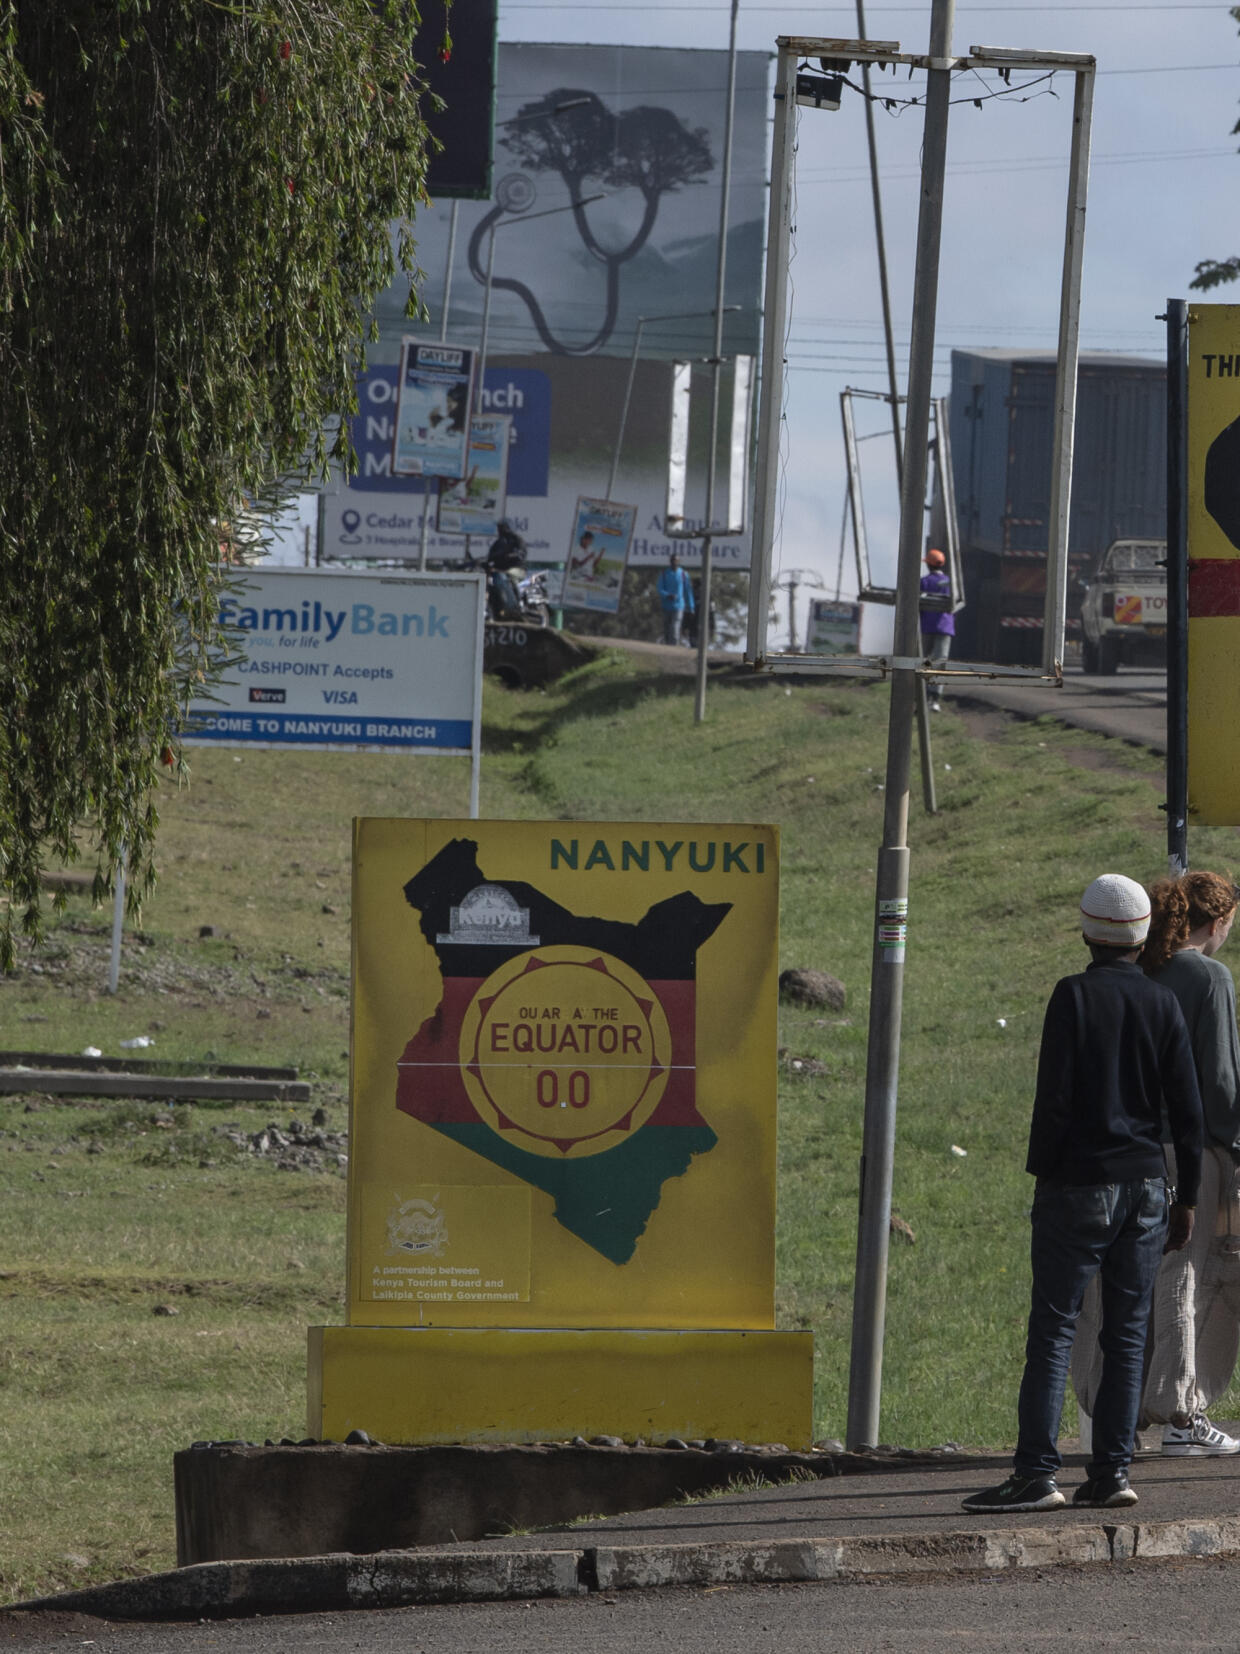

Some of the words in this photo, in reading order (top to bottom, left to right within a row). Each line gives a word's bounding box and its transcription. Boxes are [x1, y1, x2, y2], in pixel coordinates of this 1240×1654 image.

[366, 513, 413, 529] Cedar
[218, 599, 347, 643] Family
[352, 604, 450, 638] Bank
[279, 635, 298, 648] for
[299, 635, 320, 649] life
[238, 661, 330, 678] CASHPOINT
[333, 665, 394, 680] Accepts
[252, 689, 284, 702] Verve
[321, 690, 358, 705] VISA
[256, 719, 280, 733] TO
[284, 720, 361, 736] NANYUKI
[366, 724, 436, 739] BRANCH
[550, 838, 766, 875] NANYUKI
[592, 1008, 619, 1021] THE
[490, 1023, 643, 1054] EQUATOR
[372, 1265, 382, 1275] A
[383, 1265, 436, 1276] partnership
[439, 1265, 480, 1275] between
[372, 1278, 404, 1288] Kenya
[407, 1278, 448, 1287] Tourism
[450, 1278, 482, 1288] Board
[485, 1278, 504, 1288] and
[372, 1290, 414, 1300] Laikipia
[416, 1290, 453, 1301] County
[457, 1290, 520, 1301] Government
